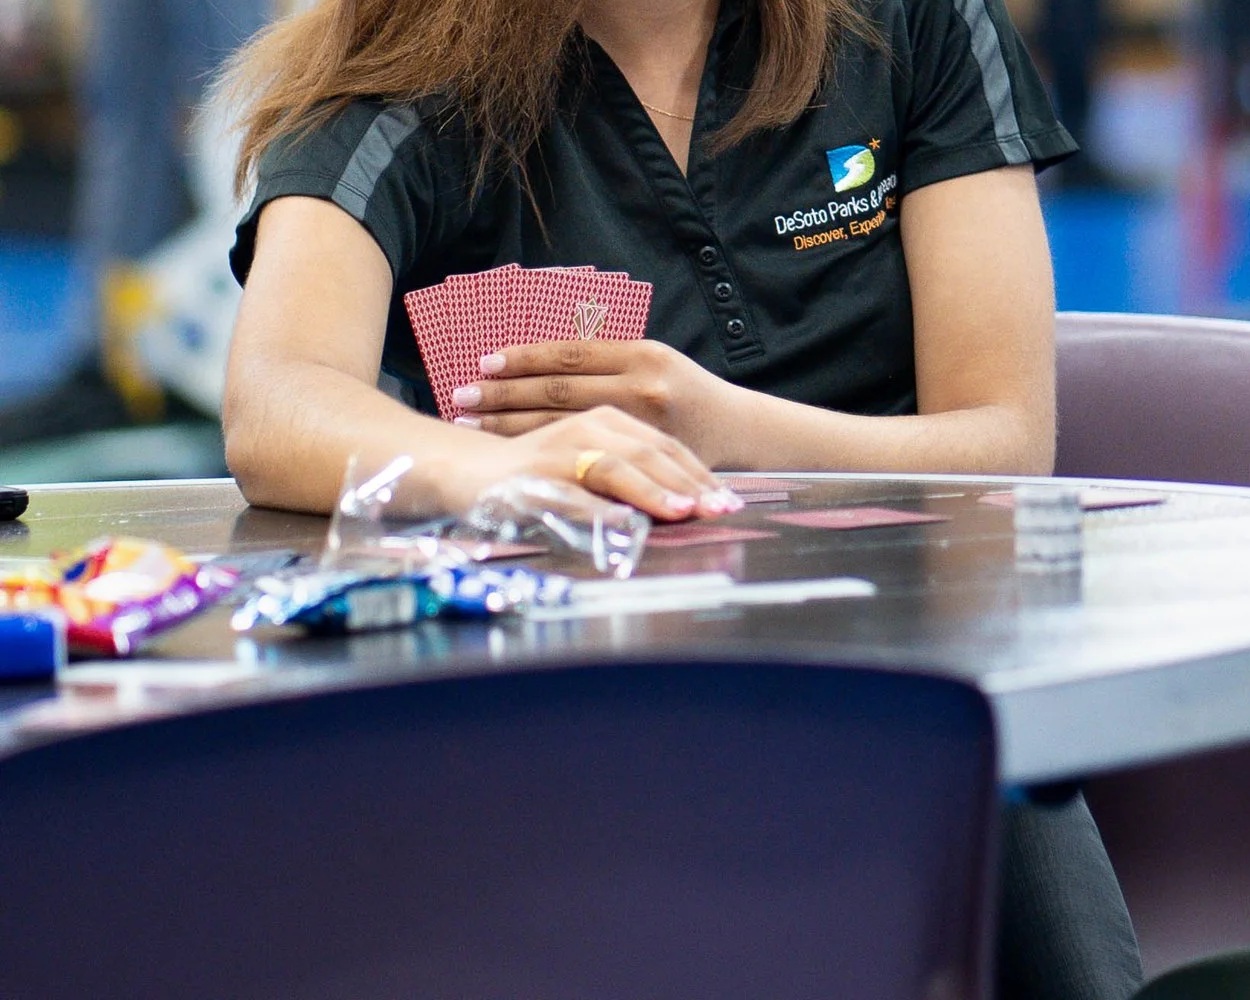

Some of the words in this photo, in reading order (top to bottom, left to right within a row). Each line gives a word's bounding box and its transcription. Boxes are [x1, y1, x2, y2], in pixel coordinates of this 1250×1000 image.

[774, 209, 828, 235] DeSoto
[827, 196, 869, 221] Parks
[870, 189, 879, 208] &
[793, 226, 848, 250] Discover,
